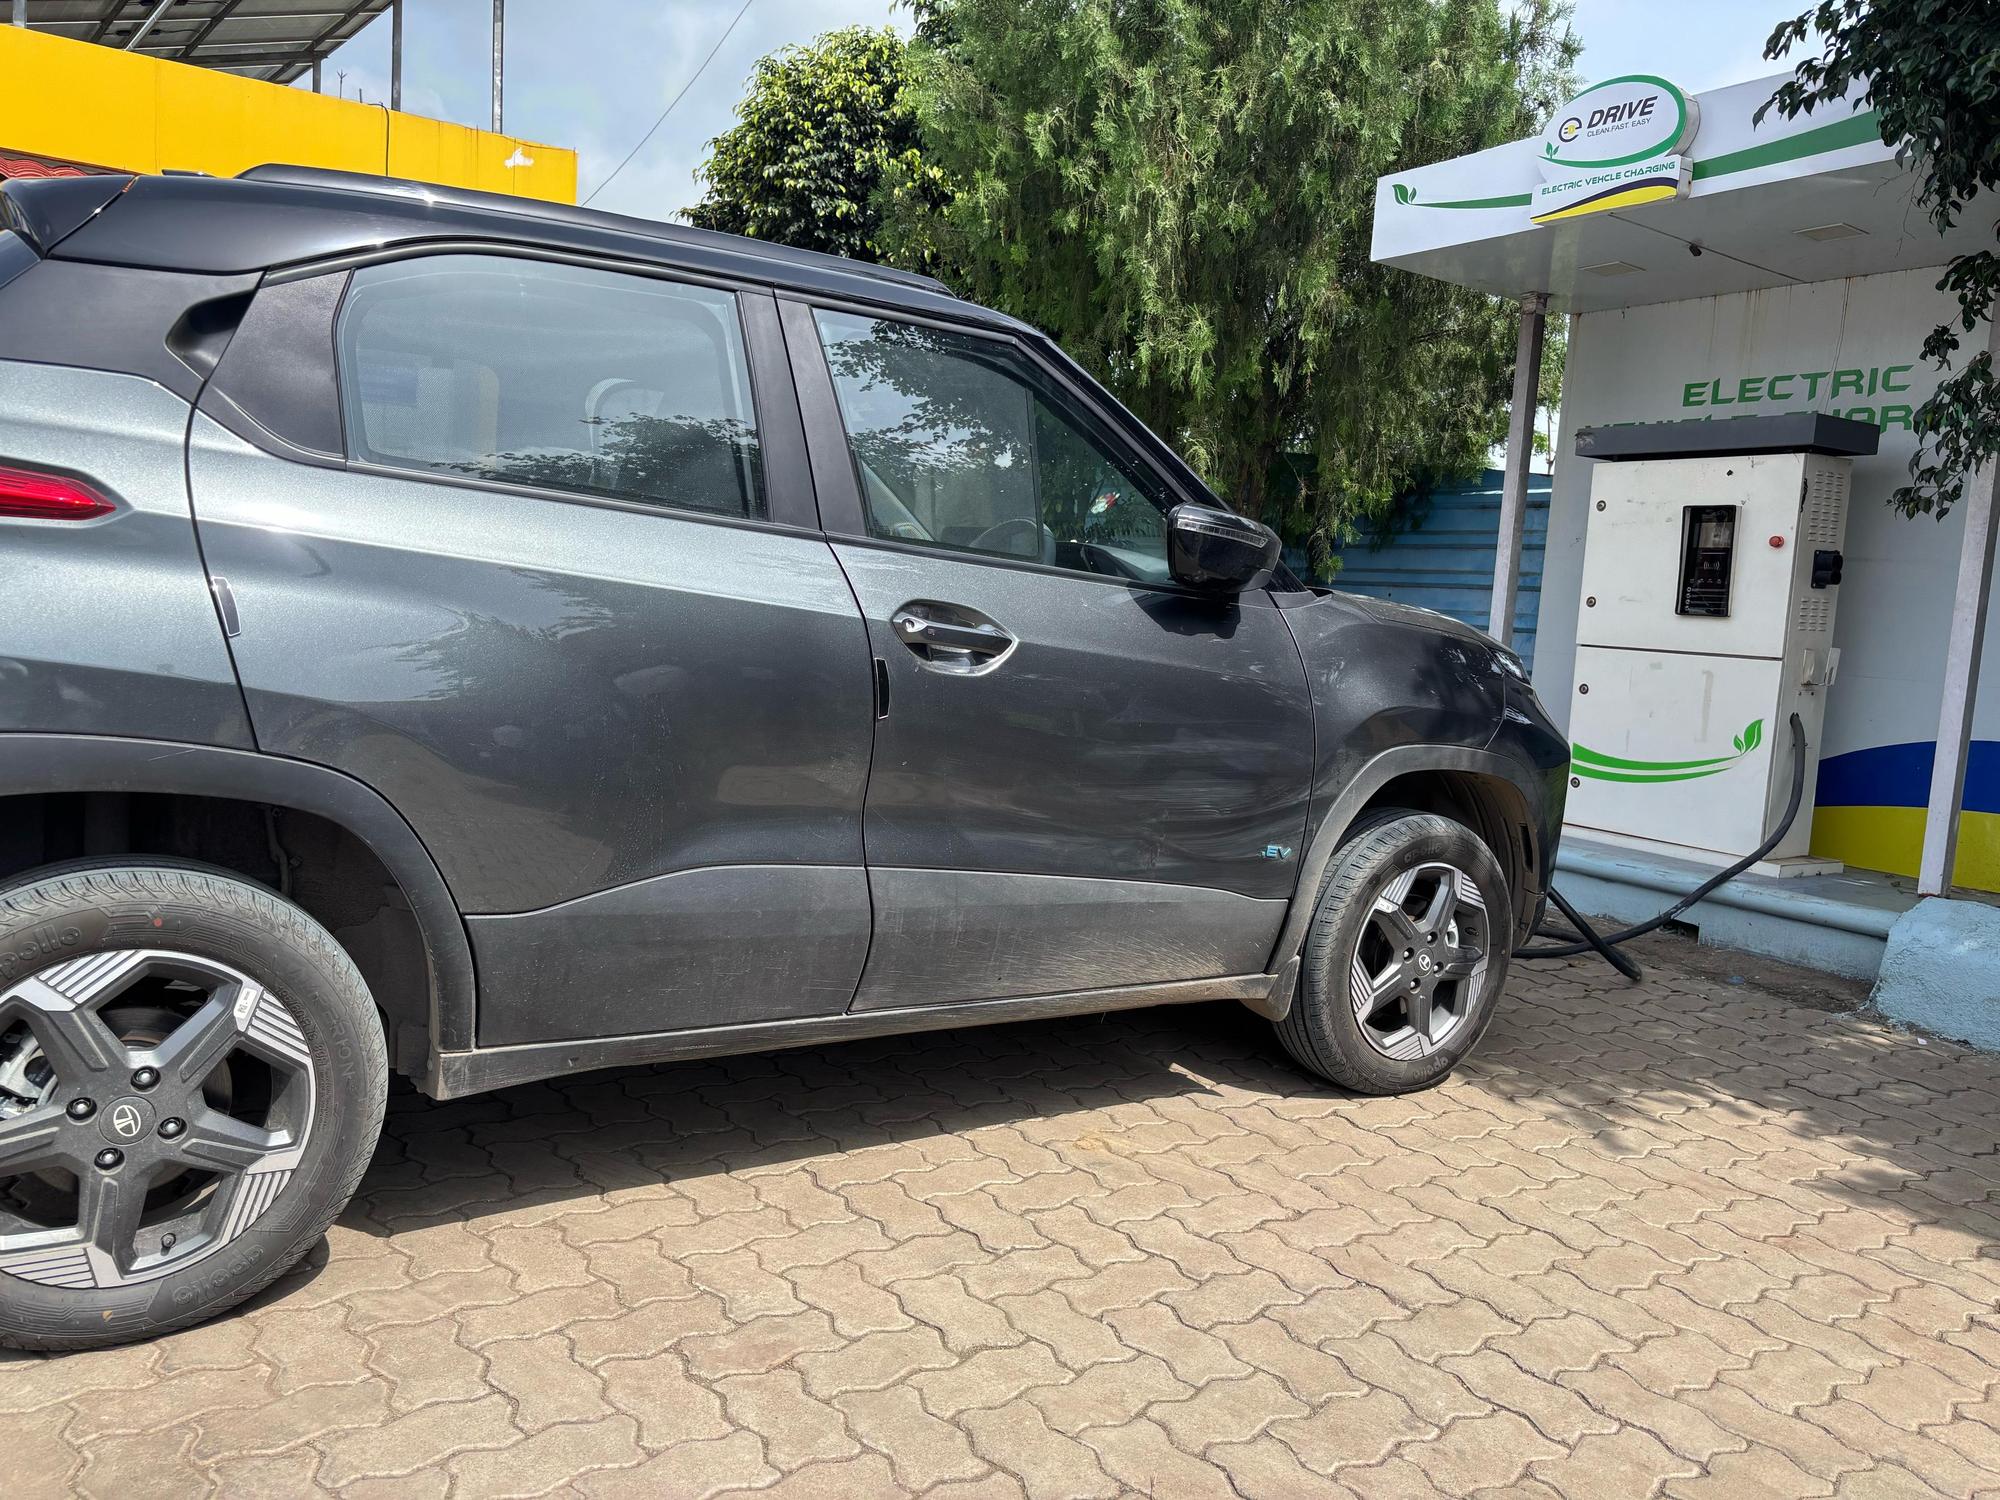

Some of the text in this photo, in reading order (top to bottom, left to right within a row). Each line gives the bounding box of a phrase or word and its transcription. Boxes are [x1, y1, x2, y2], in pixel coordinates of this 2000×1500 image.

[1586, 96, 1658, 129] DRIVE
[1541, 180, 1583, 195] ELECTRIC
[1624, 161, 1676, 178] CHARGING
[1682, 364, 1914, 407] ELECTRIC
[0, 924, 81, 980] pollo
